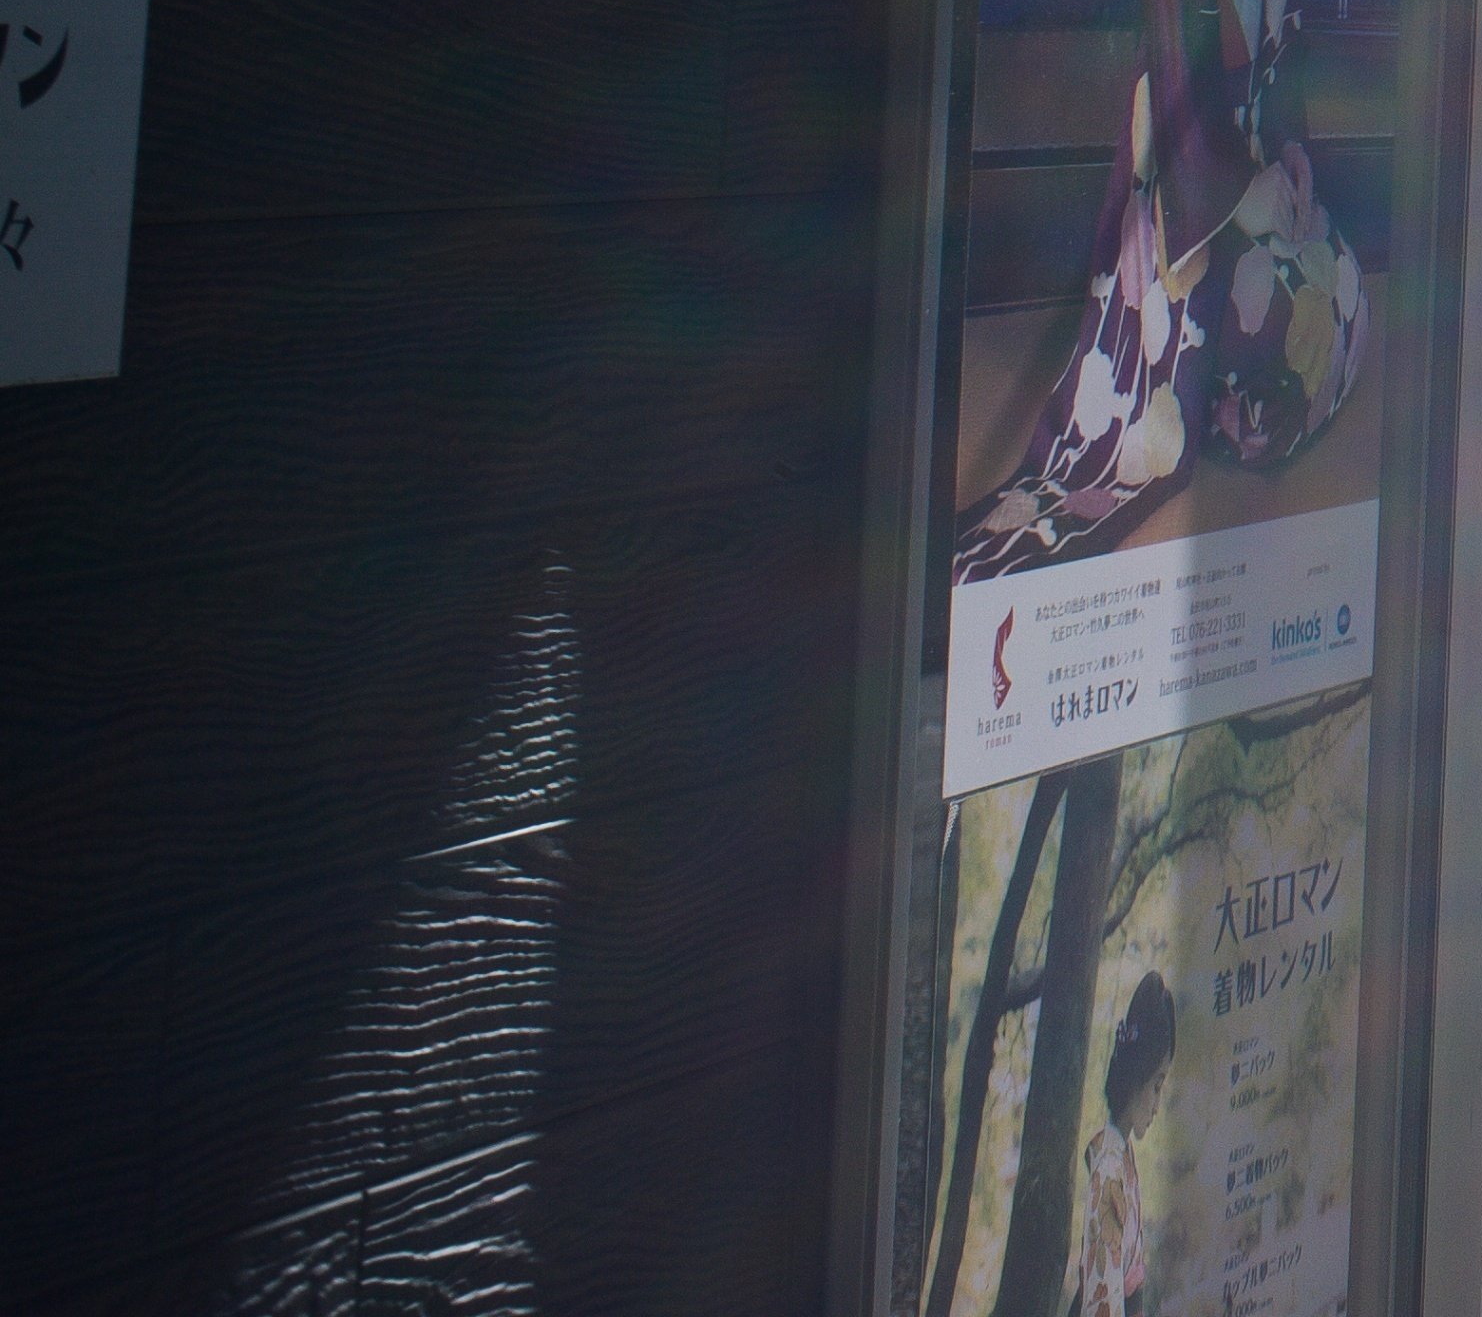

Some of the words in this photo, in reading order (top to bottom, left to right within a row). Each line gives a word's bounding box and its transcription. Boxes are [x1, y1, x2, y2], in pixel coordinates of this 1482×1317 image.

[1171, 626, 1186, 646] TEL
[1271, 610, 1321, 650] kinko's
[1049, 677, 1139, 728] はれまロマン
[977, 711, 1021, 736] harema
[985, 733, 1012, 751] roman
[1213, 856, 1344, 955] 大正ロマン
[1212, 930, 1336, 1017] 着物レンタル
